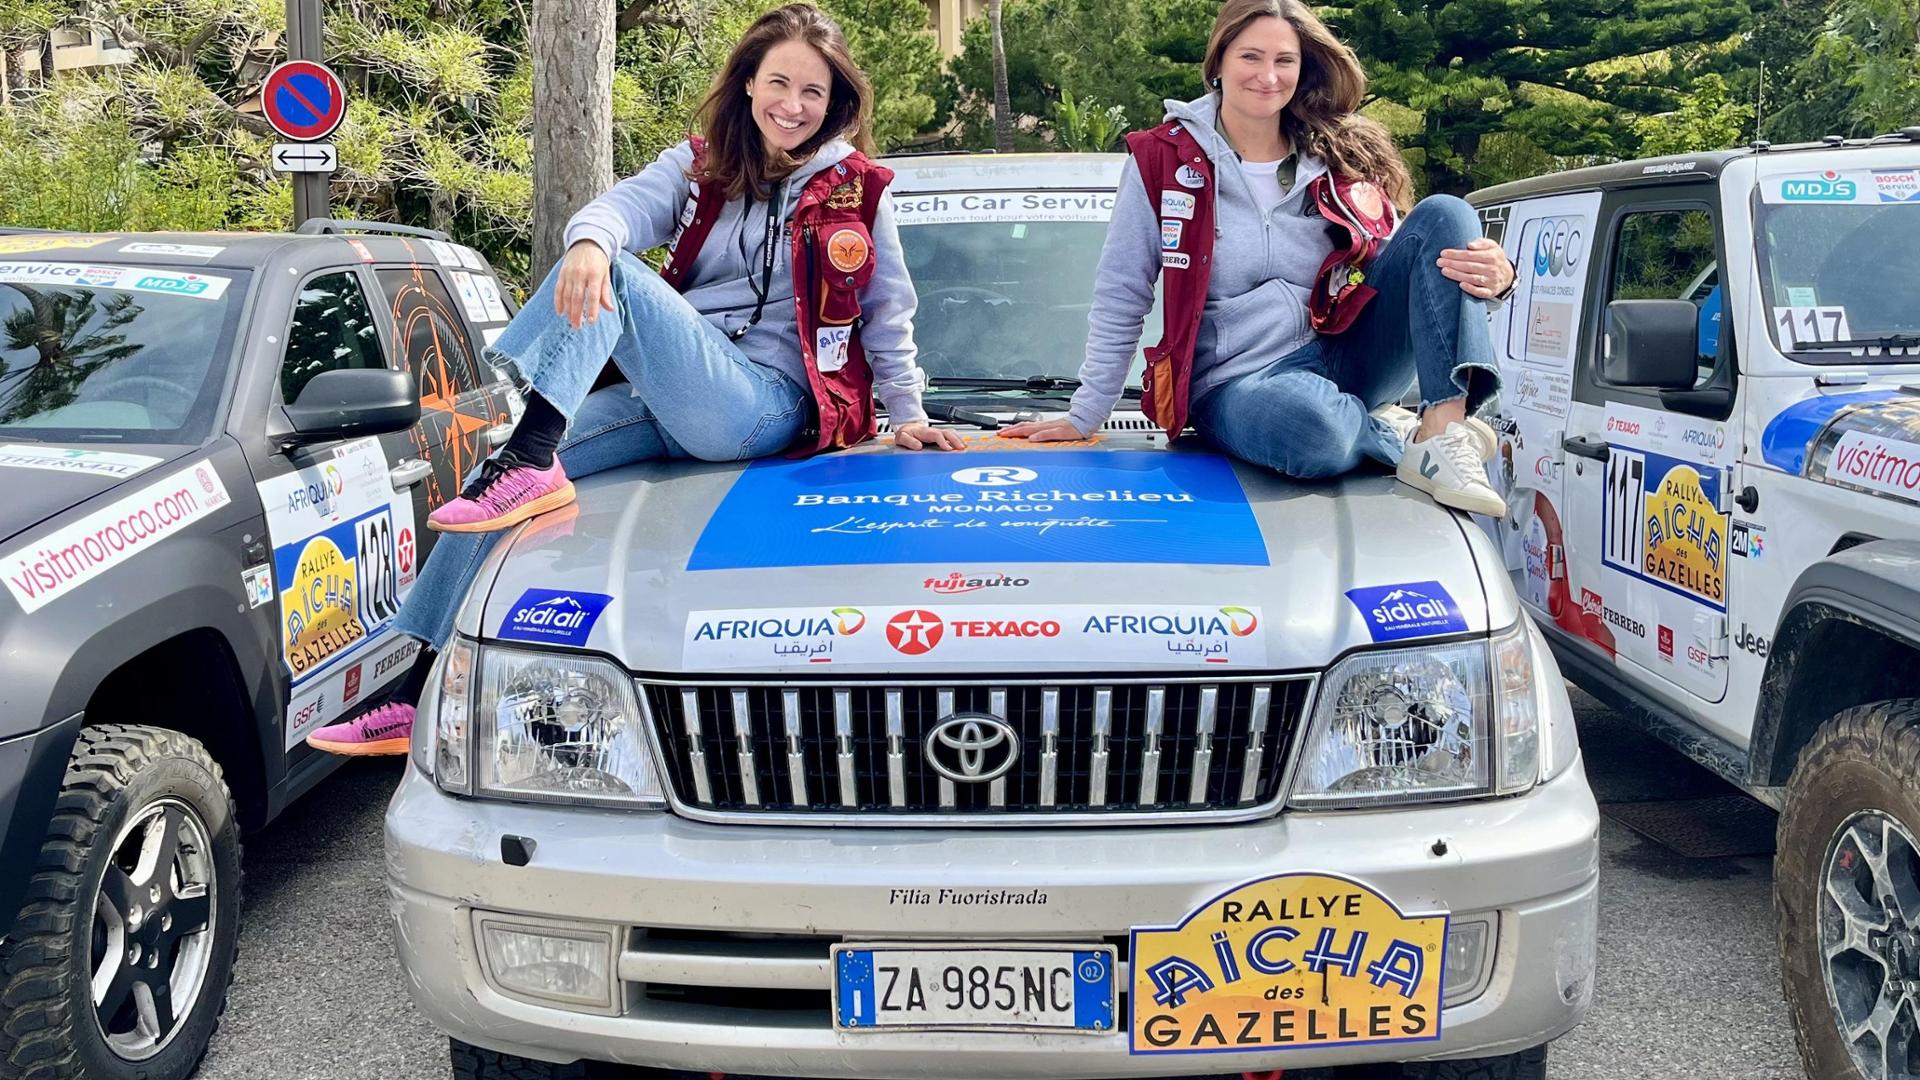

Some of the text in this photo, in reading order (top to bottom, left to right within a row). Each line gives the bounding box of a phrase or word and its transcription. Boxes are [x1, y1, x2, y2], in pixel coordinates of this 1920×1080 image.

[1787, 182, 1850, 196] MDJS
[894, 194, 1113, 213] sch Car Servic
[970, 213, 993, 221] tout
[997, 214, 1023, 223] pour
[1026, 213, 1055, 221] votre
[1060, 212, 1098, 221] voiture
[766, 215, 775, 267] PORSCHE
[86, 268, 122, 276] BOSCH
[142, 277, 205, 292] MDJS
[1780, 309, 1843, 347] 117
[1615, 419, 1640, 436] TEXACO
[1681, 429, 1717, 448] AFRIQUIA
[0, 455, 129, 475] THERMAL
[1837, 441, 1920, 490] visitmo
[288, 480, 335, 514] AFRIQUIA
[793, 489, 1194, 506] Banque Richelieu
[928, 504, 1054, 513] MONACO
[1608, 453, 1643, 565] 117
[811, 516, 947, 534] L'esprit
[953, 518, 989, 529] de
[11, 488, 199, 599] visitmorocco.com
[1732, 529, 1748, 553] 2M
[1675, 547, 1688, 559] des
[301, 550, 336, 578] RALLYE
[360, 517, 397, 624] 128
[923, 574, 1030, 592] fujiauto
[1645, 552, 1721, 600] GAZELLES
[513, 607, 586, 629] sidi ali
[1372, 598, 1449, 624] sidi ali
[317, 619, 328, 631] des
[694, 618, 835, 641] AFRIQUIA
[950, 620, 1061, 638] TEXACO
[1083, 615, 1229, 636] AFRIQUIA
[1603, 606, 1646, 639] FERRERO
[290, 619, 362, 672] GAZELLES
[1687, 646, 1708, 666] GSF
[293, 701, 317, 729] GSF
[889, 889, 1048, 905] Filia Fuoristrada
[1222, 894, 1362, 923] RALLYE
[1085, 965, 1099, 979] 02
[878, 965, 1072, 1012] ZA 985NC
[1263, 986, 1304, 1001] des
[1143, 1004, 1427, 1047] GAZELLES
